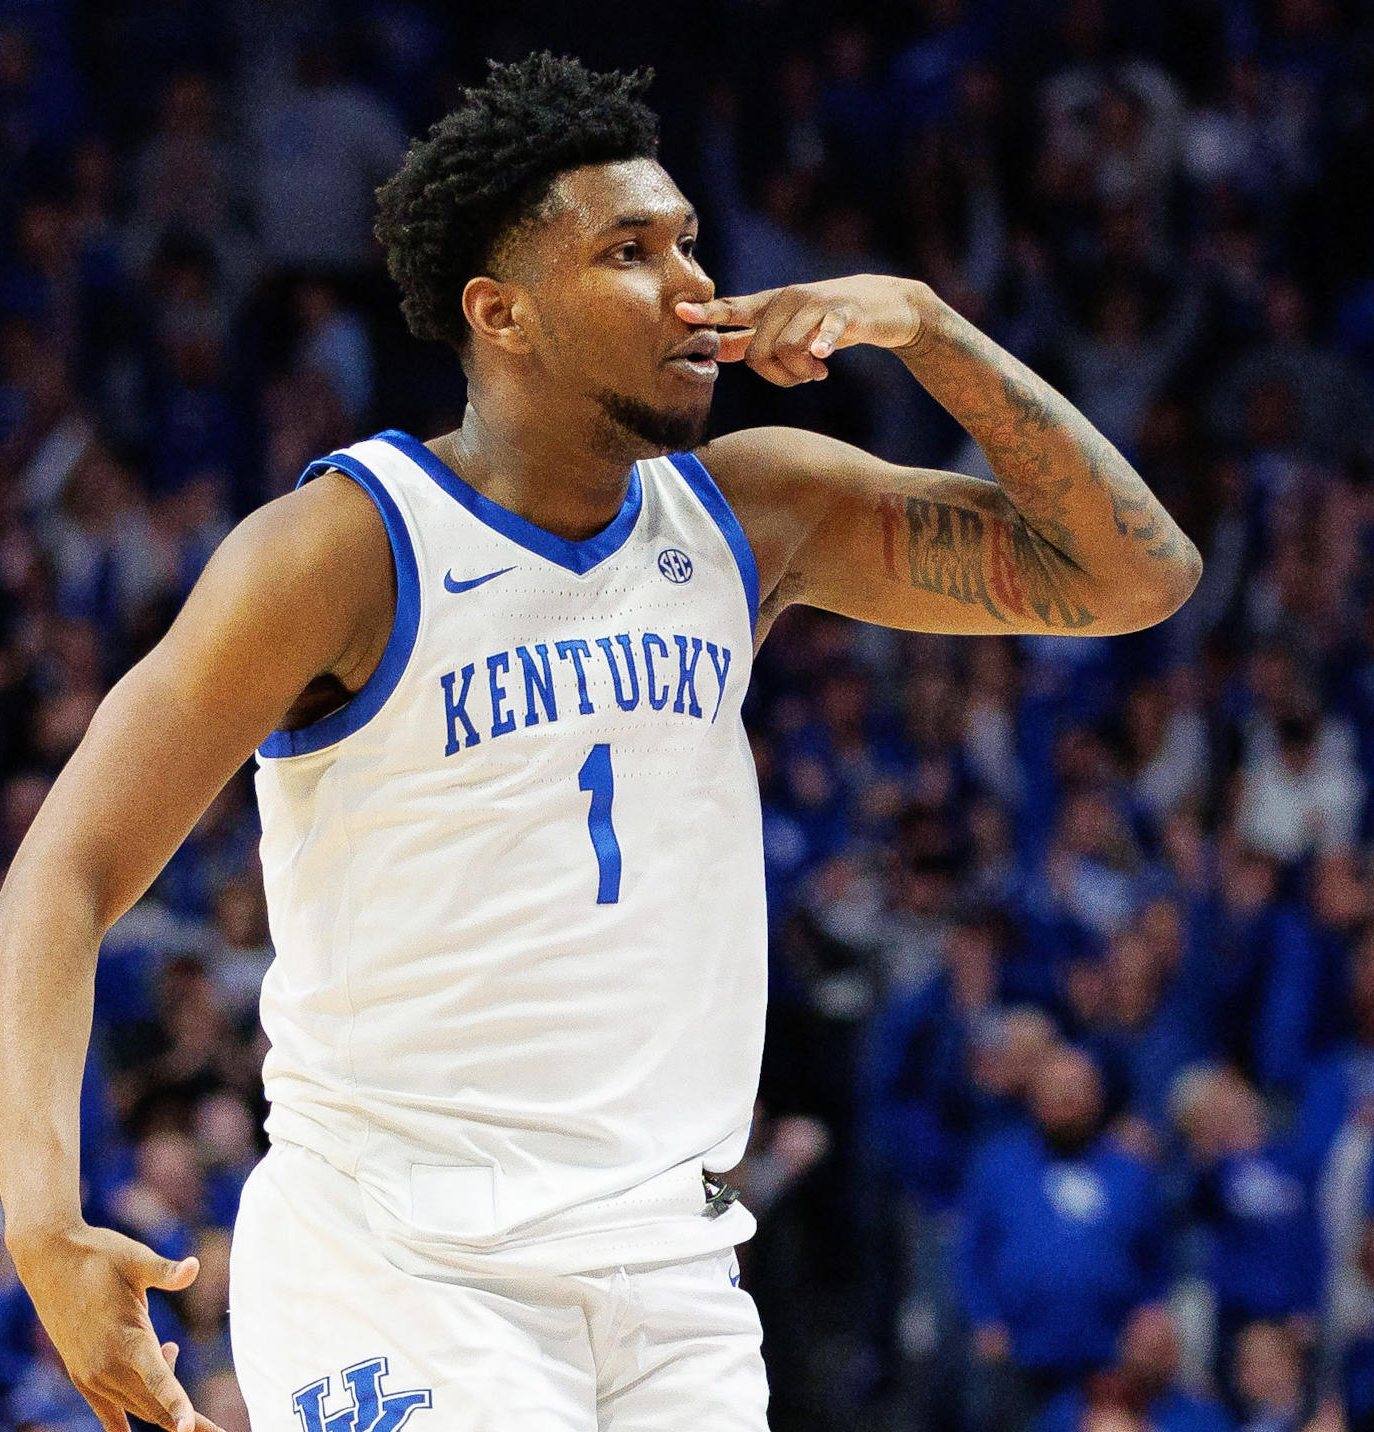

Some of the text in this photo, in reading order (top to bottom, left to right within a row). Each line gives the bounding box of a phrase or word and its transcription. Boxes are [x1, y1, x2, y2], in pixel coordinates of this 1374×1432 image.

[658, 549, 693, 584] SEC
[440, 632, 731, 758] KENTUCKY
[578, 744, 622, 904] 1
